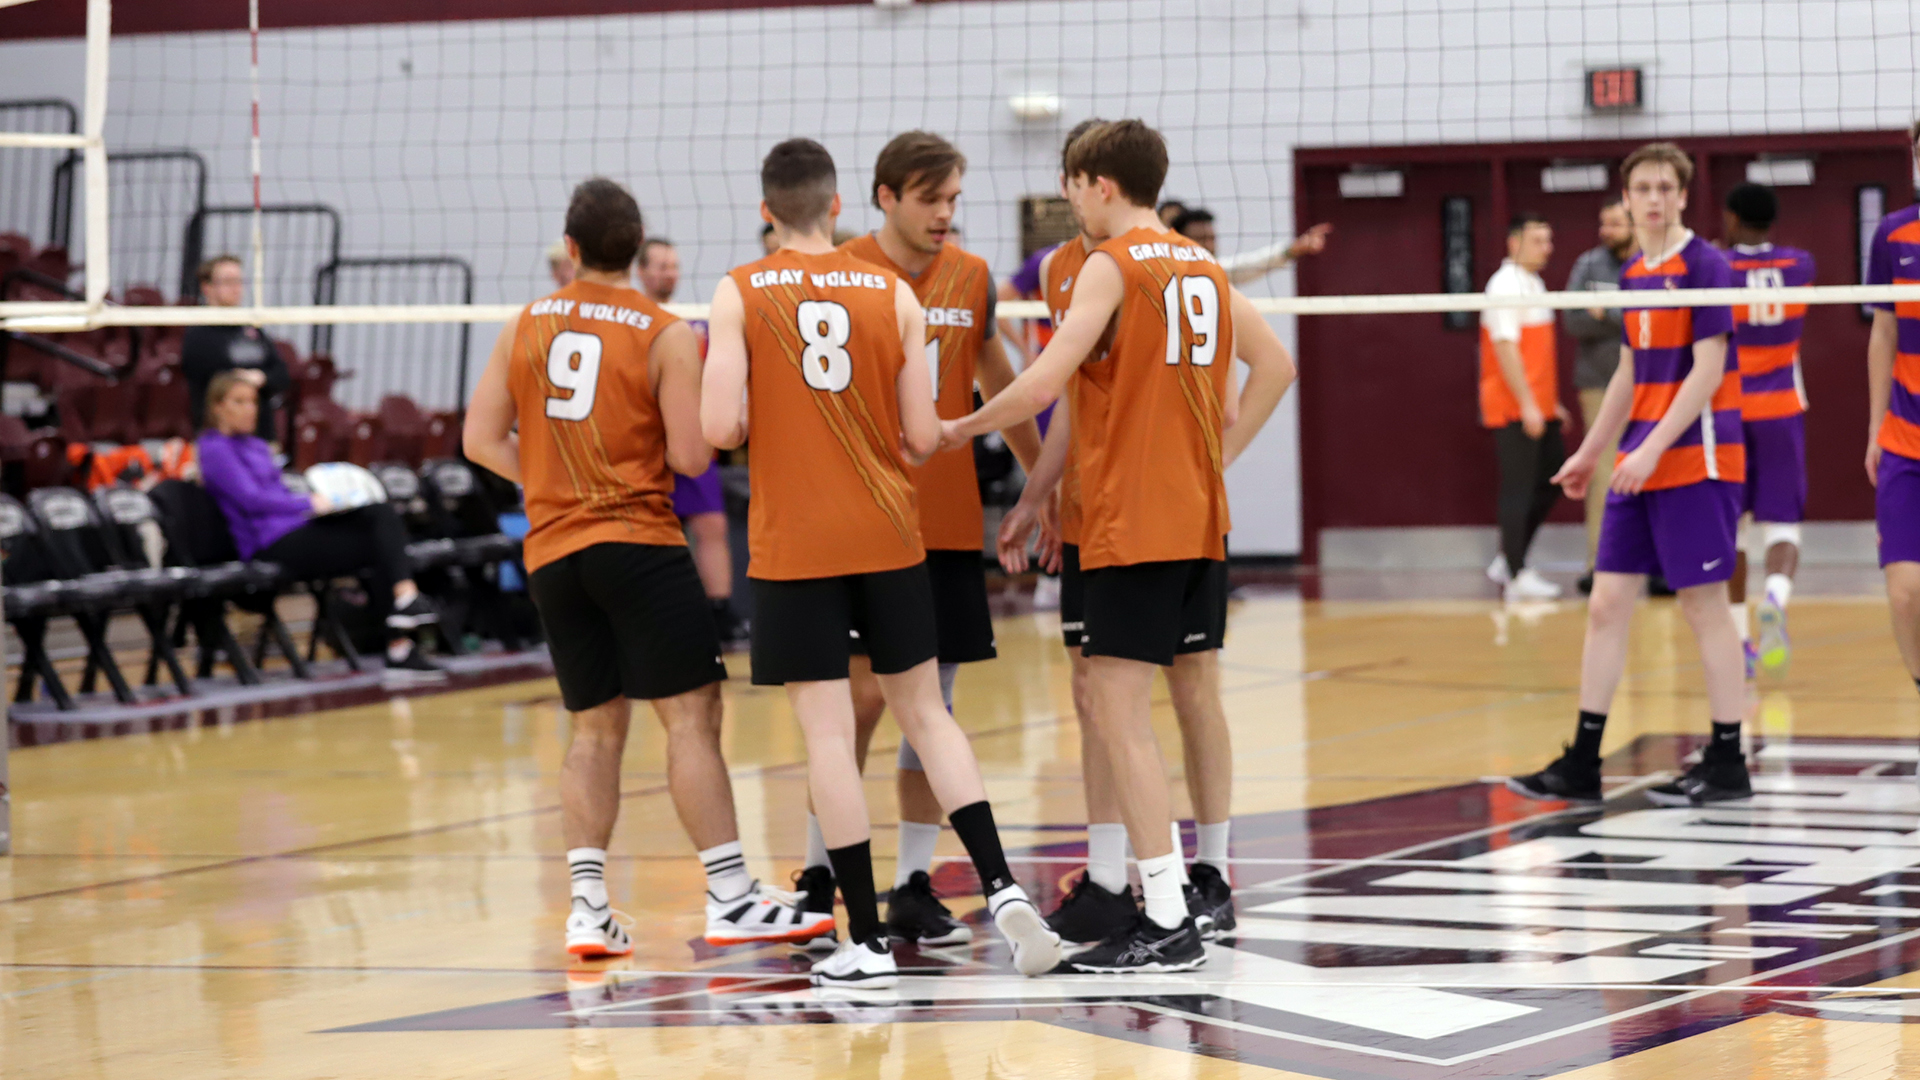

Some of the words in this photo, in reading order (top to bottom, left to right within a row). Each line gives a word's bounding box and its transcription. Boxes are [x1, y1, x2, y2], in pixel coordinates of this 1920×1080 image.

[750, 269, 804, 288] GRAY
[810, 270, 887, 290] WOLVES
[1128, 242, 1170, 261] GRAY
[530, 298, 576, 316] GRAY
[579, 302, 653, 330] WOLVES
[1162, 273, 1219, 366] 19
[1746, 267, 1785, 325] 10
[546, 330, 603, 421] 9
[797, 300, 852, 393] 8
